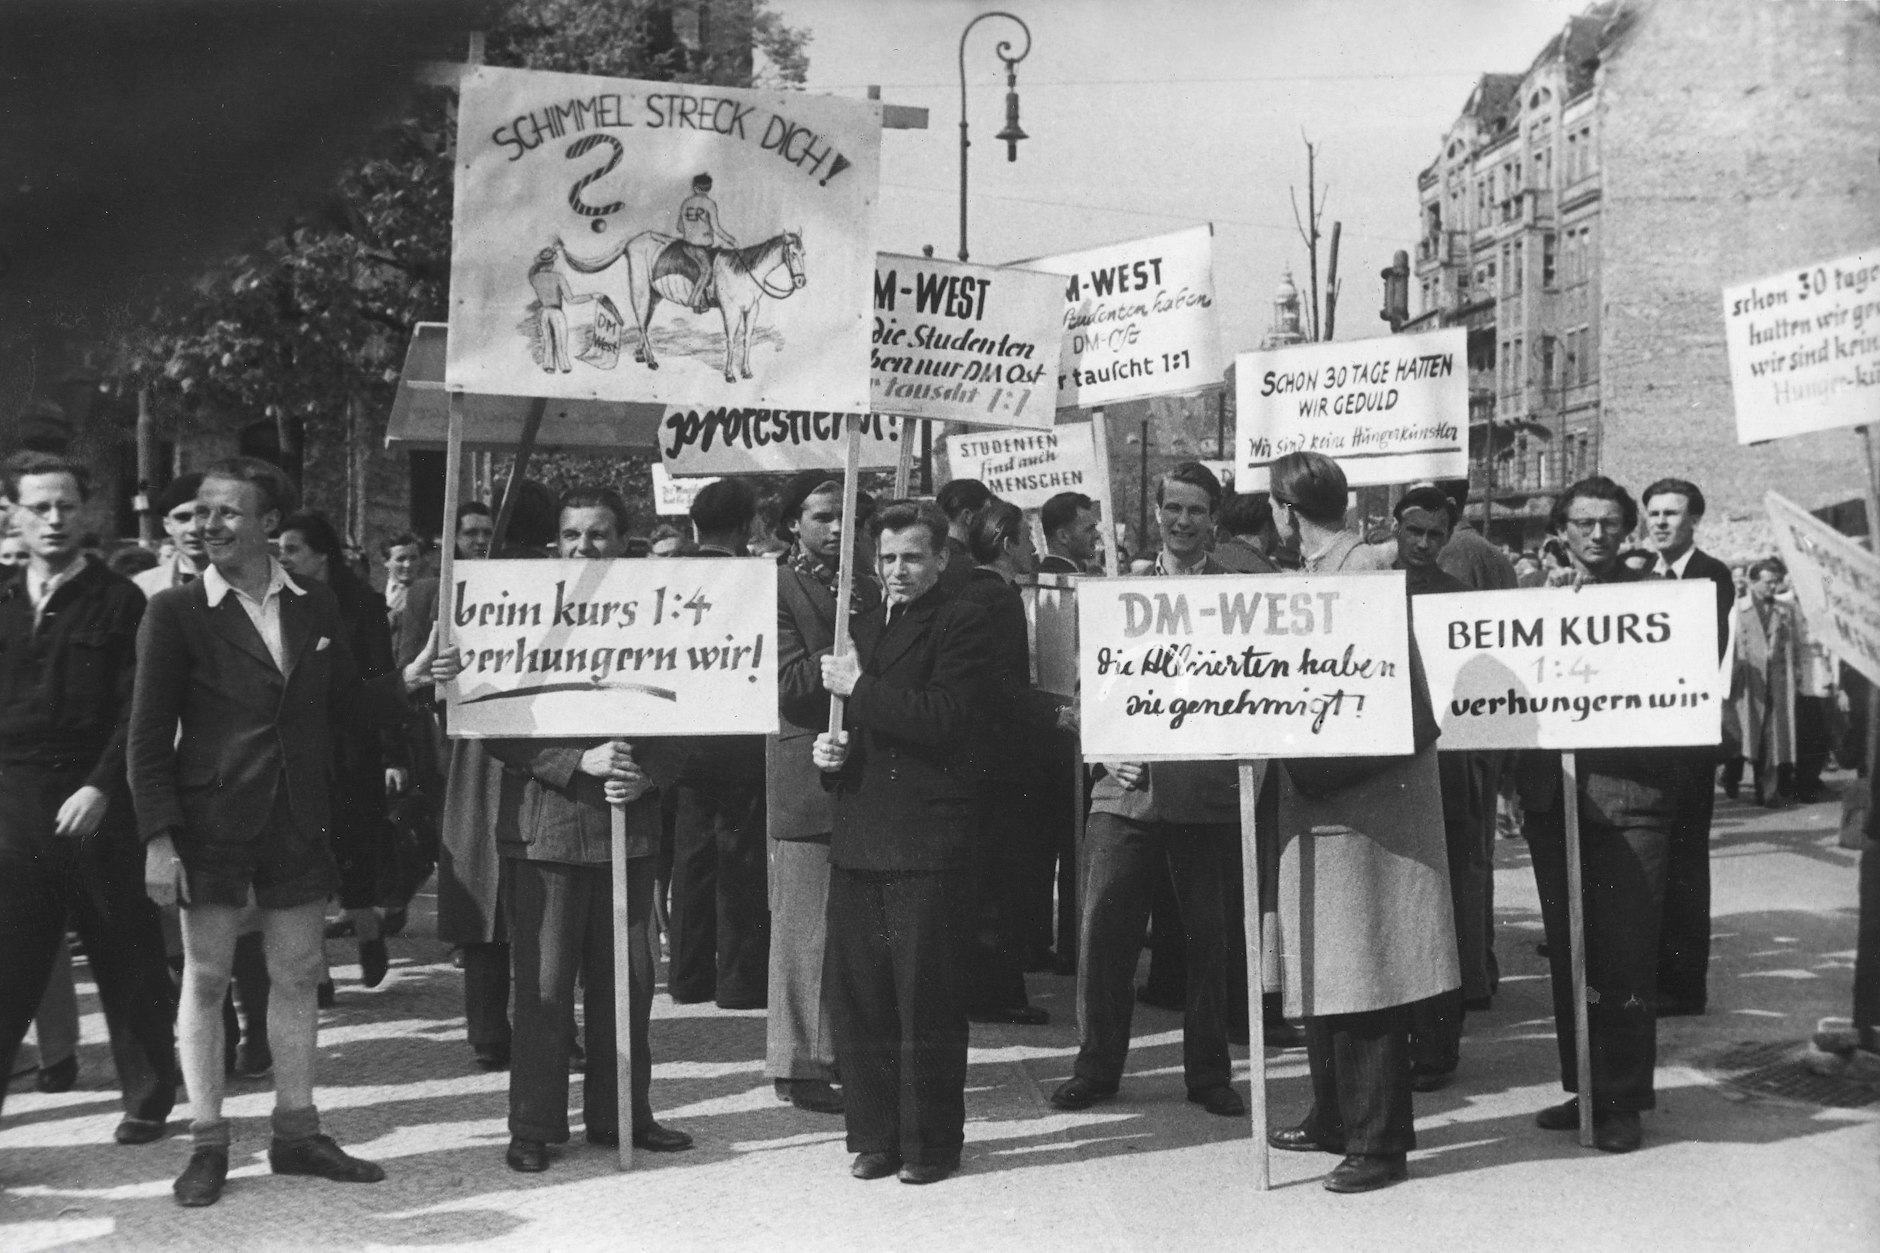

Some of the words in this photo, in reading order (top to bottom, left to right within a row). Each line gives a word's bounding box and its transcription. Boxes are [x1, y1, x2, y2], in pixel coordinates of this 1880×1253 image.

[492, 95, 633, 162] SCHIMMEL
[646, 94, 757, 140] STRECK
[760, 115, 852, 188] DICH!
[1798, 267, 1828, 300] 30
[907, 324, 1036, 360] Studenten
[914, 359, 964, 377] nur
[962, 360, 1002, 384] DM
[1006, 362, 1048, 384] Ost
[1162, 349, 1190, 374] 1:1
[1323, 365, 1348, 390] 30
[1352, 360, 1391, 385] TAGE
[1395, 353, 1454, 383] HATTEN
[987, 387, 1032, 418] 1:1
[1298, 396, 1329, 418] WIR
[1333, 388, 1399, 416] GEDULD
[960, 434, 1059, 459] STUDENTEN
[988, 470, 1084, 494] MENSCHEN
[454, 580, 542, 628] beim
[653, 585, 713, 627] 1:4
[1118, 592, 1342, 639] DM-WEST
[1448, 617, 1545, 650] BEIM
[1560, 612, 1672, 647] KURS
[687, 633, 765, 684] wir!
[1297, 643, 1397, 679] haben
[1530, 655, 1600, 684] 1:4
[1450, 687, 1643, 723] verhungern
[1648, 676, 1711, 709] wir
